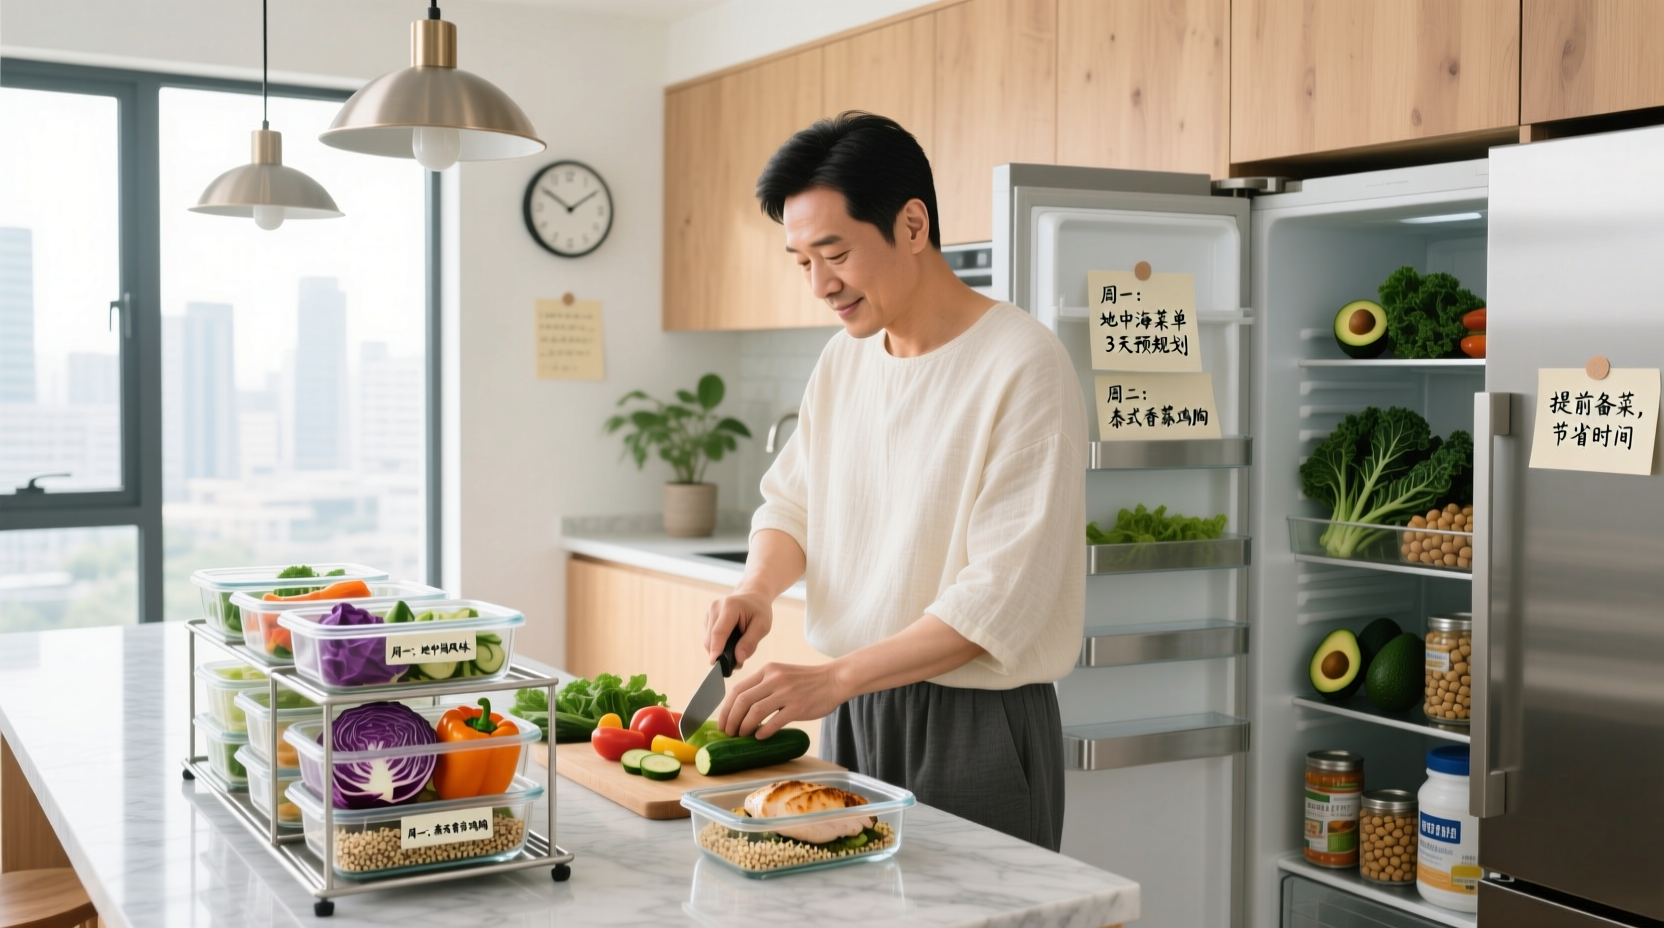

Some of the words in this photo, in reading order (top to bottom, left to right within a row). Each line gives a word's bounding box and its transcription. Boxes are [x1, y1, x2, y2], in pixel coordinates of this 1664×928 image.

[1101, 285, 1141, 305] 周一：
[1100, 309, 1187, 331] 地中海菜单
[1105, 335, 1189, 356] 3天预规划
[1107, 385, 1147, 404] 周二：
[1549, 391, 1643, 419] 提前备菜，
[1552, 421, 1633, 450] 节省时间
